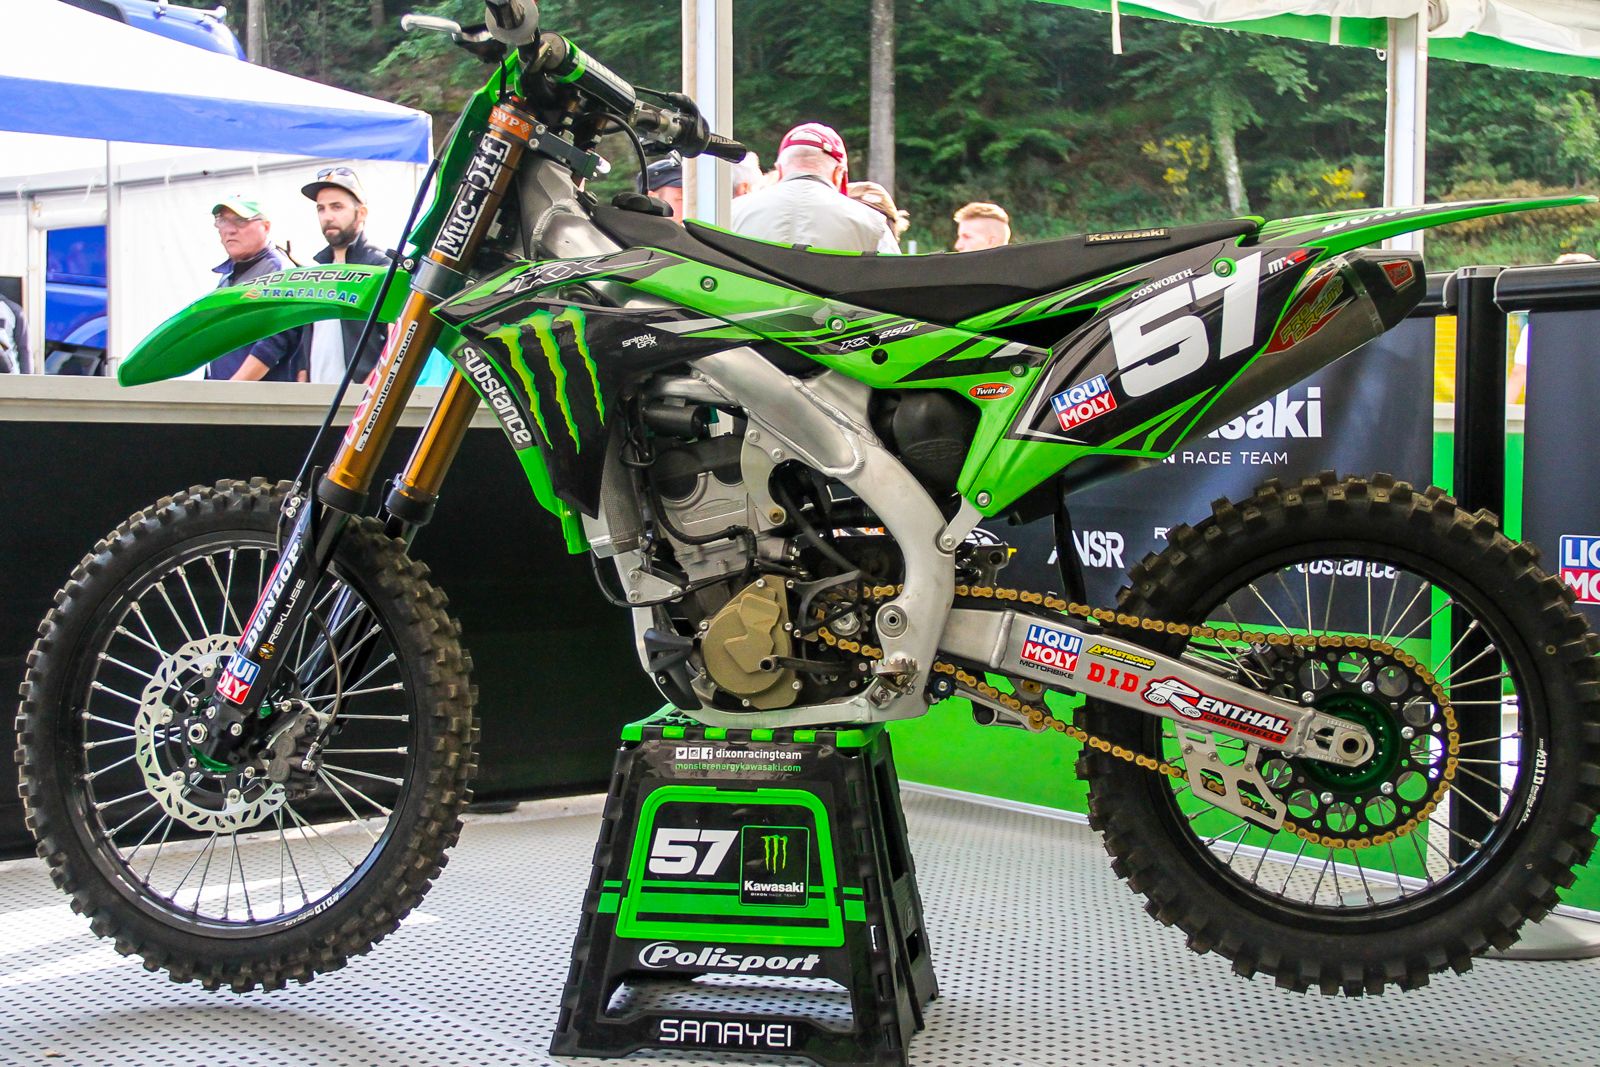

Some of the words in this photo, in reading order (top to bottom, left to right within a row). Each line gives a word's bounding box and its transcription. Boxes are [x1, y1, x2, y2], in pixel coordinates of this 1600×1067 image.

[437, 138, 507, 255] Muc-Off
[1089, 228, 1165, 242] Kawasaki
[288, 270, 373, 283] CIRCUIT
[1131, 268, 1194, 300] COSWORTH
[262, 288, 358, 305] TRAFALGAR
[1109, 251, 1262, 398] 57
[622, 334, 653, 348] SPIRAL
[362, 371, 396, 438] Technical
[394, 323, 417, 366] Touch
[976, 386, 996, 397] Twin
[996, 386, 1011, 395] Air
[1052, 375, 1107, 411] LIQUI
[463, 347, 532, 444] substance
[1061, 393, 1116, 428] MOLY
[1203, 387, 1322, 440] saki
[1183, 452, 1231, 464] RACE
[1240, 452, 1288, 465] TEAM
[1047, 530, 1125, 569] NSR
[245, 542, 299, 652] DUNLOP
[268, 578, 306, 645] REKLUSE
[1029, 626, 1080, 652] LIQUI
[1019, 660, 1074, 680] MOTORBIKE
[1024, 643, 1077, 670] MOLY
[1088, 645, 1155, 667] ARMSTRONG
[1204, 714, 1284, 743] CHAINWHEELS
[675, 762, 801, 772] monsterenergykawasaki.com
[716, 748, 801, 761] dixonracingteam
[648, 828, 739, 875] 57
[744, 880, 804, 893] Kawasaki
[638, 941, 821, 972] Polisport
[659, 1019, 792, 1047] SANAYEI
